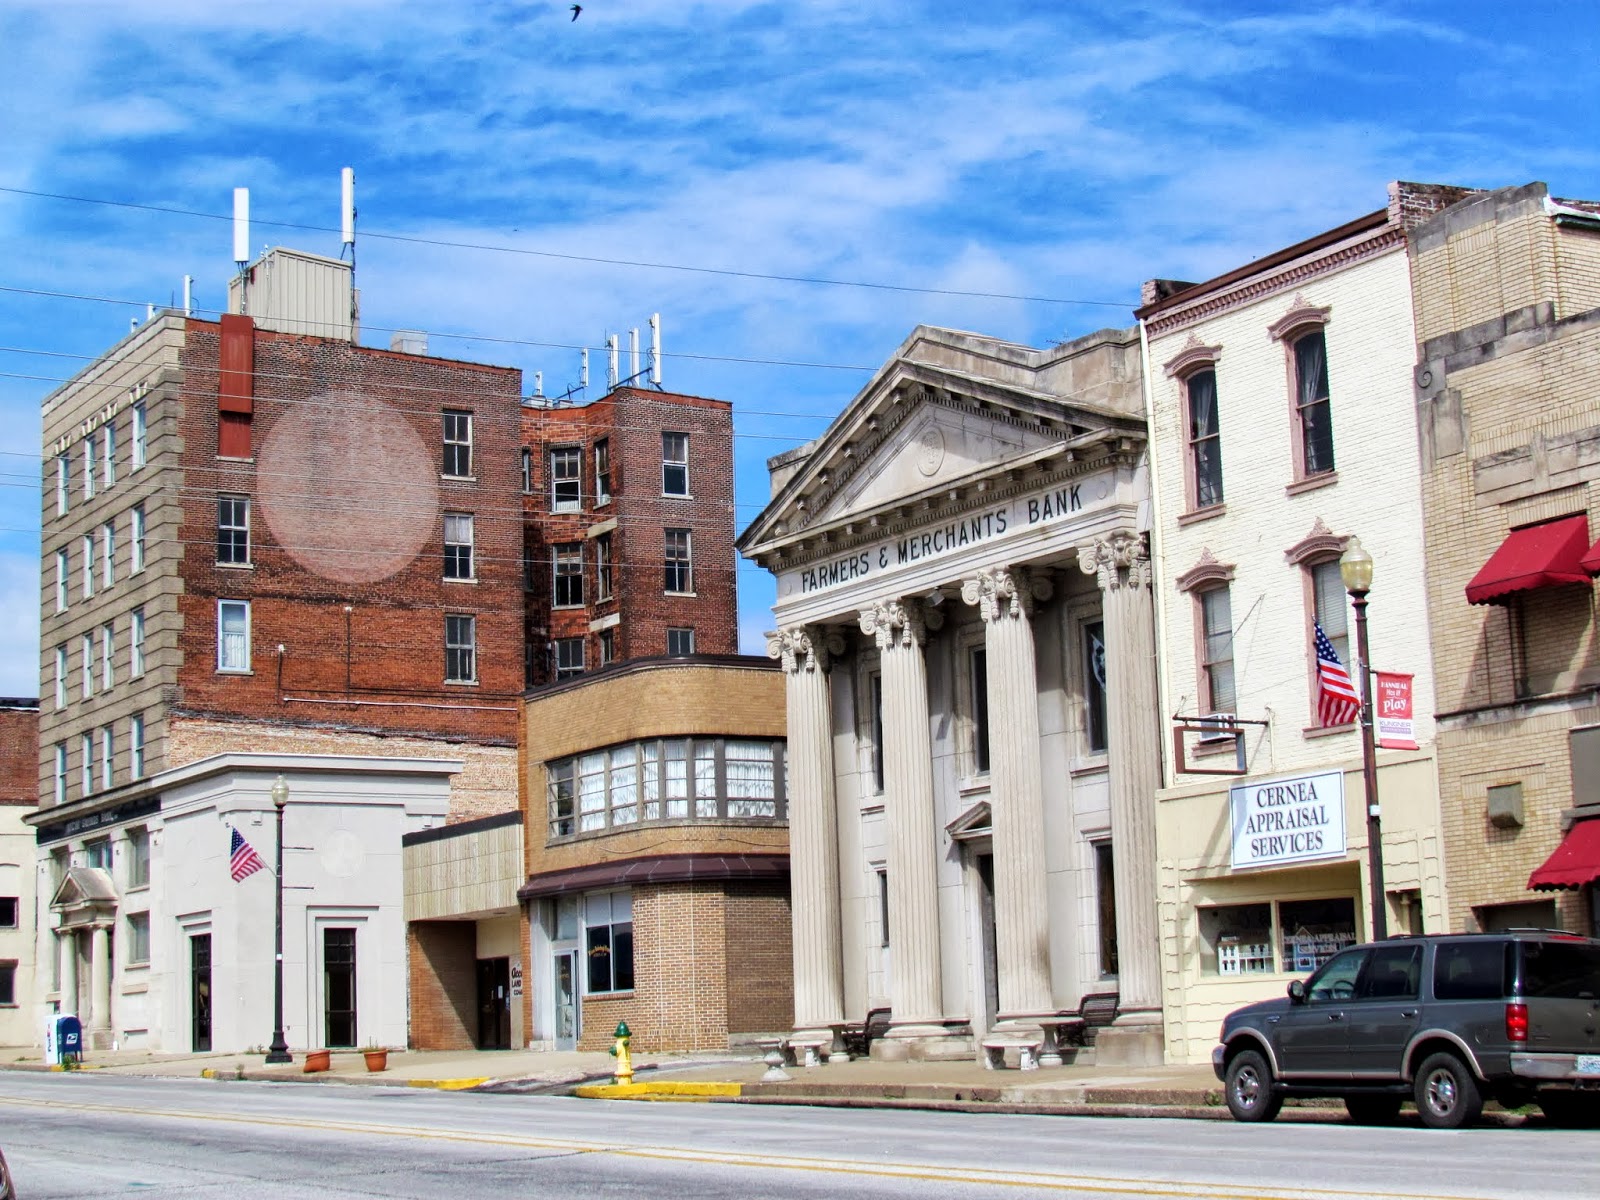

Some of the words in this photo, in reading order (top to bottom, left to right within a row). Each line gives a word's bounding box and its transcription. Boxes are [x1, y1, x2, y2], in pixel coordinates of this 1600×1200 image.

[801, 550, 870, 594] FARMERS
[879, 548, 889, 569] &
[897, 508, 1007, 565] MERCHANTS
[1028, 484, 1084, 525] BANK
[1256, 781, 1318, 808] CERNEA
[1245, 805, 1329, 835] APPRAISAL
[1251, 830, 1323, 858] SERVICES
[1315, 932, 1356, 943] APPRAISAL
